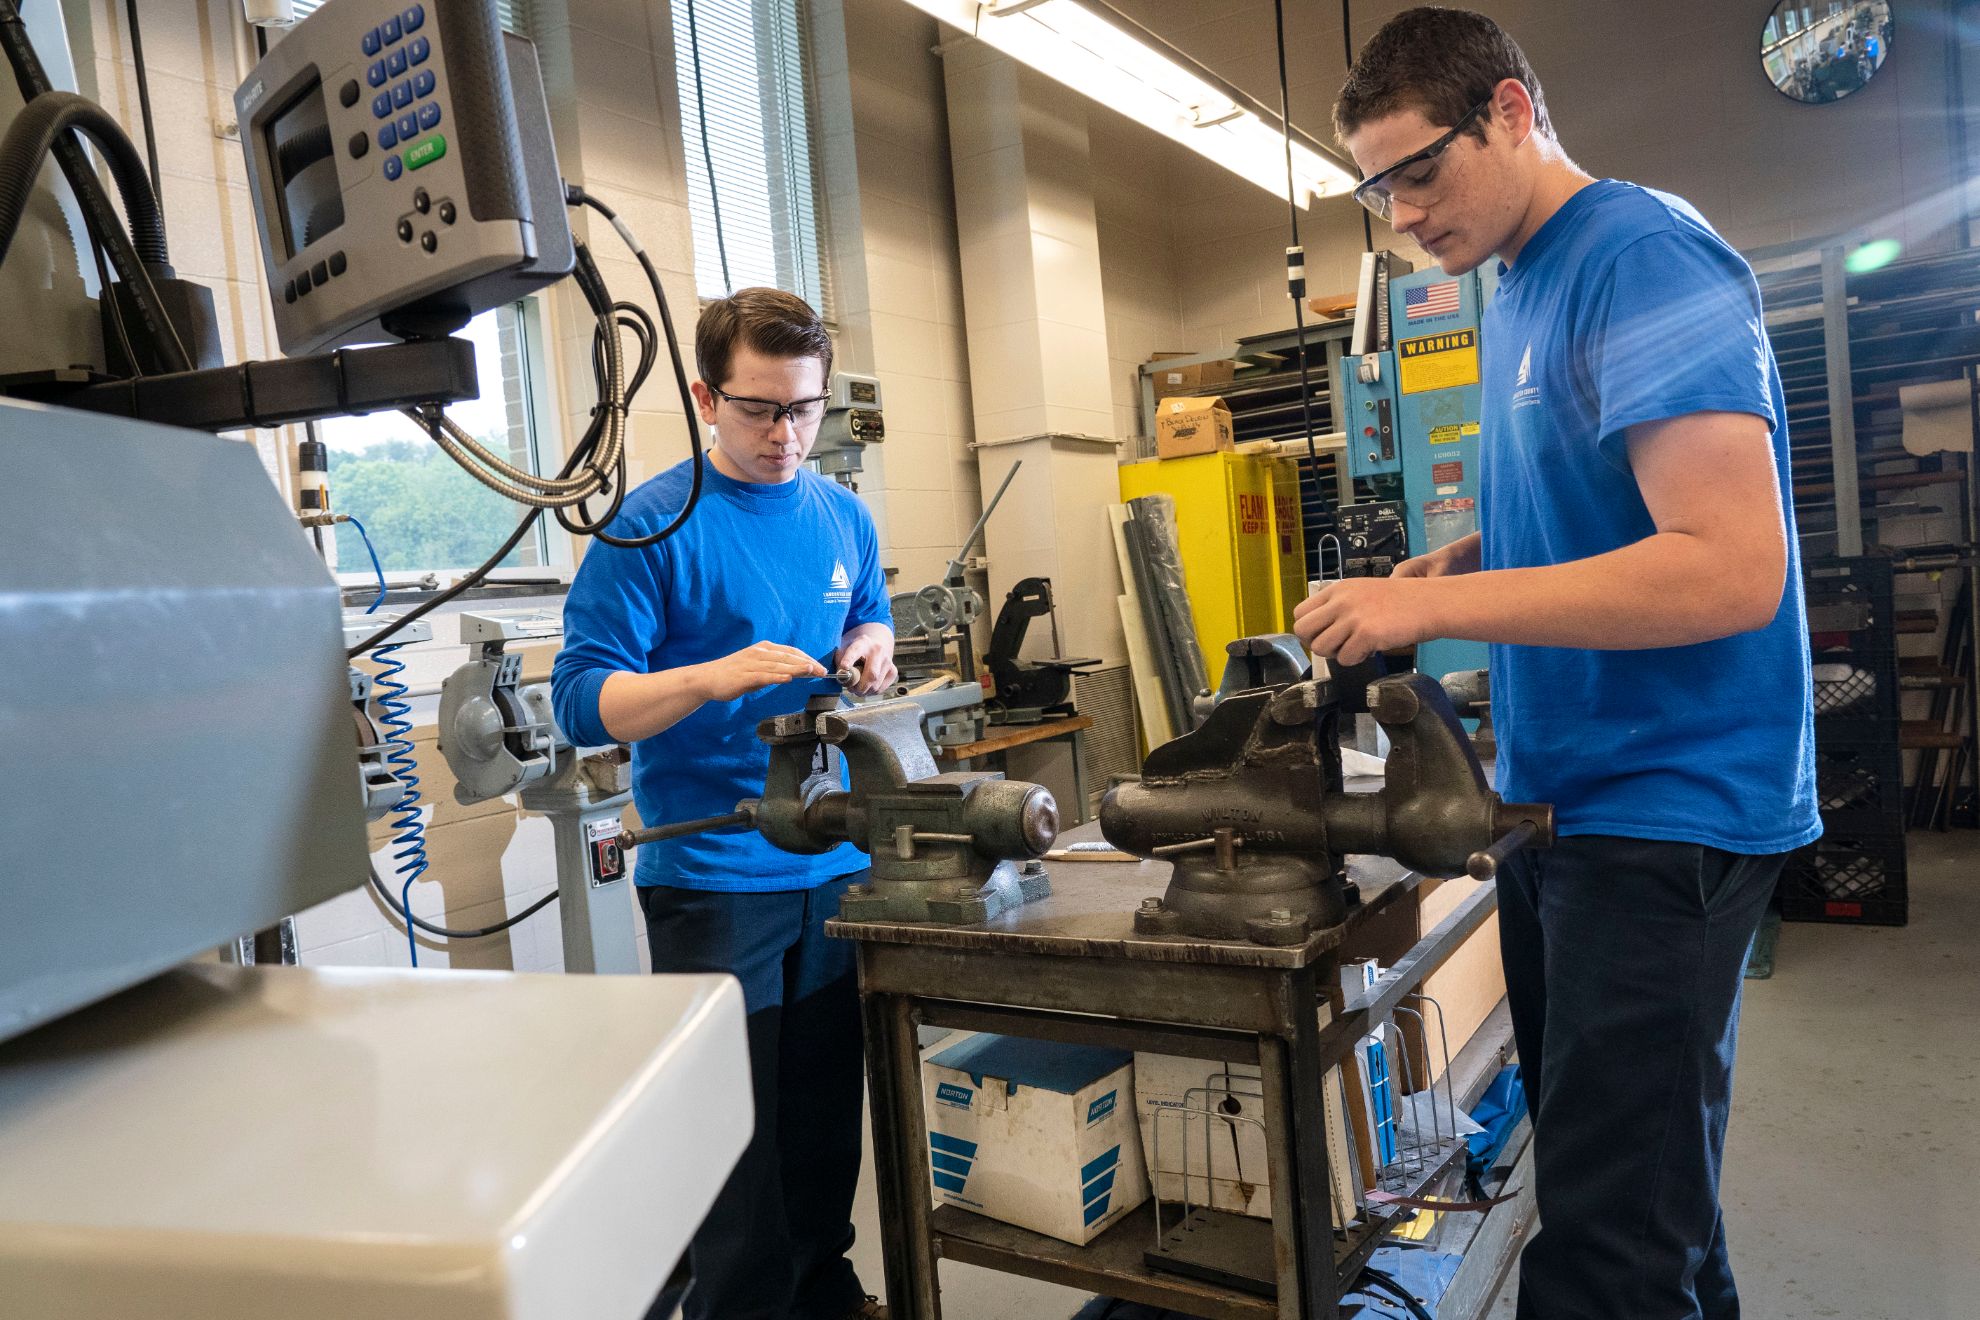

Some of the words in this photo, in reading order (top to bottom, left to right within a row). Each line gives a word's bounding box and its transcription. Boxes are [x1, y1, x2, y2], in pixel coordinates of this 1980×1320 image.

[410, 142, 435, 162] ENTER
[1408, 318, 1425, 326] MADE
[1405, 333, 1469, 355] WARNING
[1242, 521, 1259, 534] KEEP
[1201, 807, 1264, 823] WILTON
[940, 1086, 969, 1101] NORTON
[1090, 1097, 1115, 1117] NORTON
